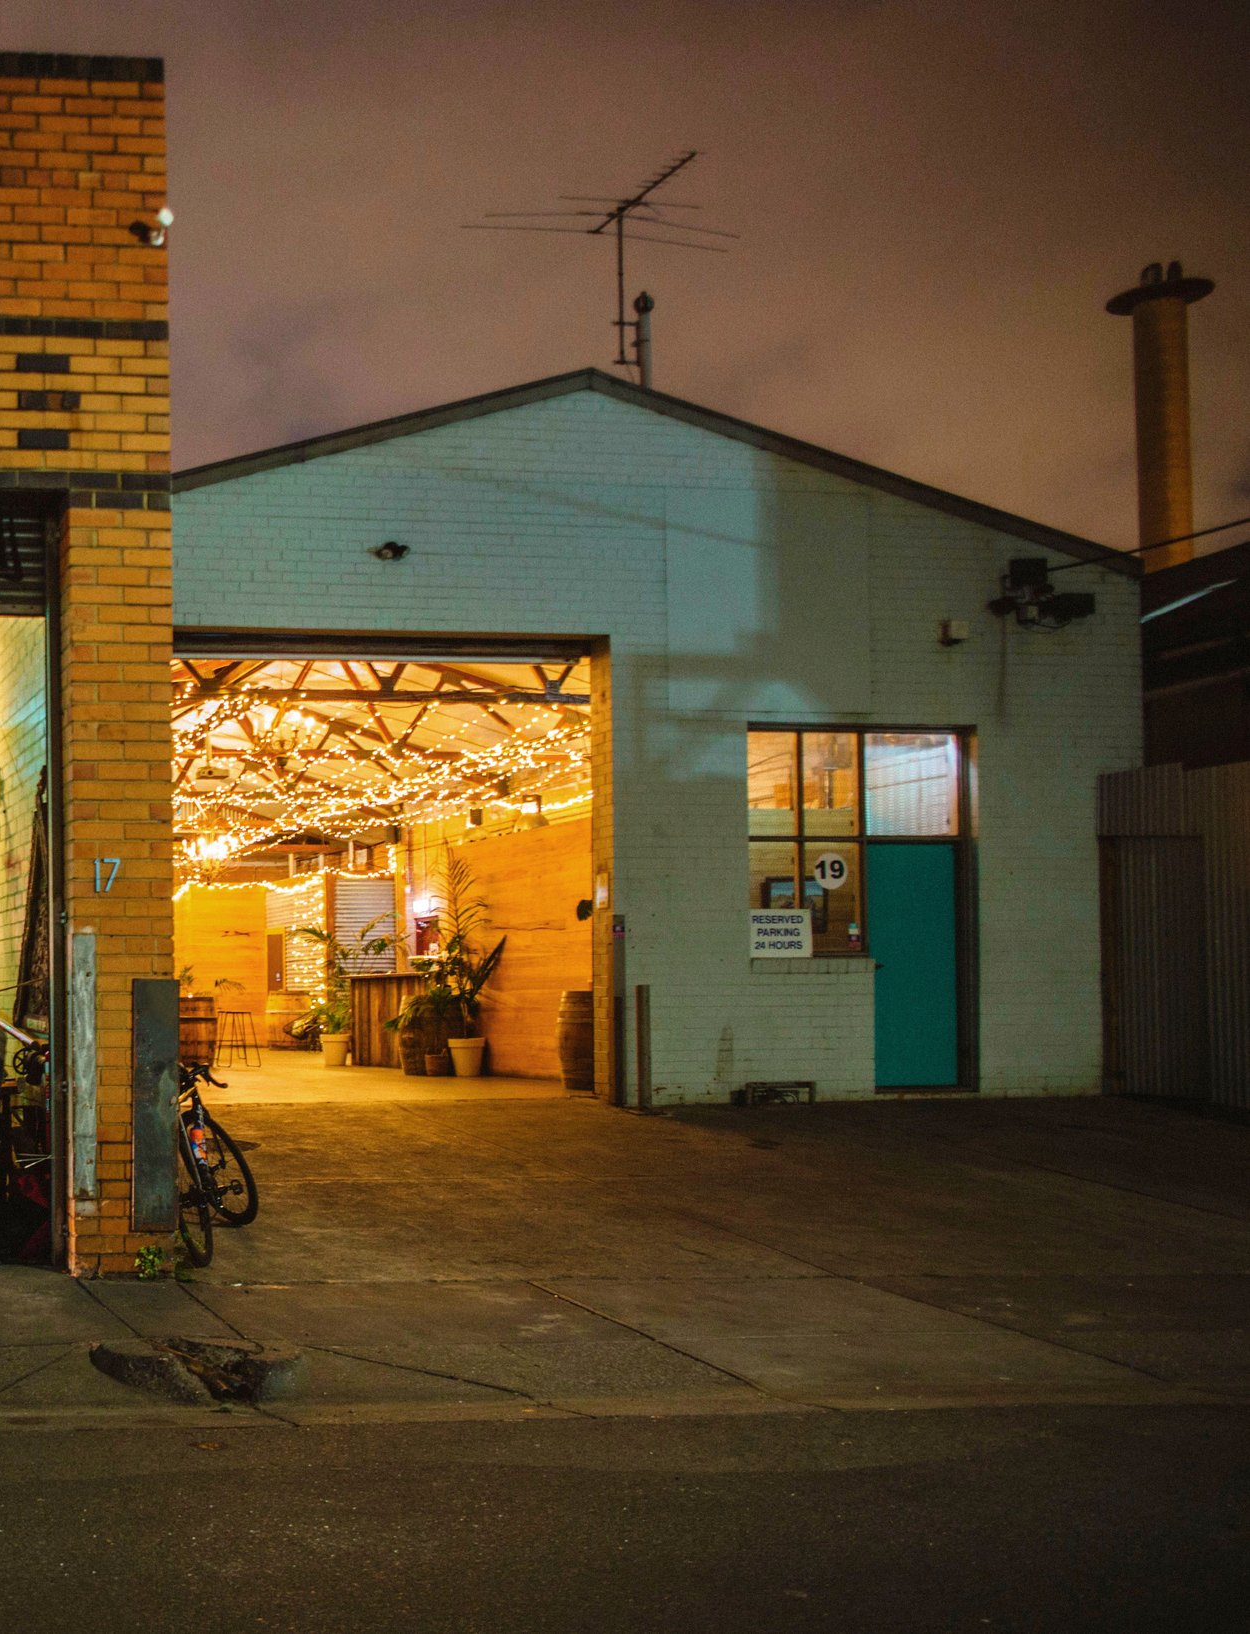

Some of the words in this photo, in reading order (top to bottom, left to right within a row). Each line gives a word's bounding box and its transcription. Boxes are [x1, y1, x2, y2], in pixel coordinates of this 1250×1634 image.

[94, 857, 121, 892] 17
[815, 860, 845, 880] 19
[752, 915, 804, 924] RESERVED
[757, 928, 801, 937] PARKING
[754, 941, 766, 950] 24
[768, 940, 803, 950] HOURS
